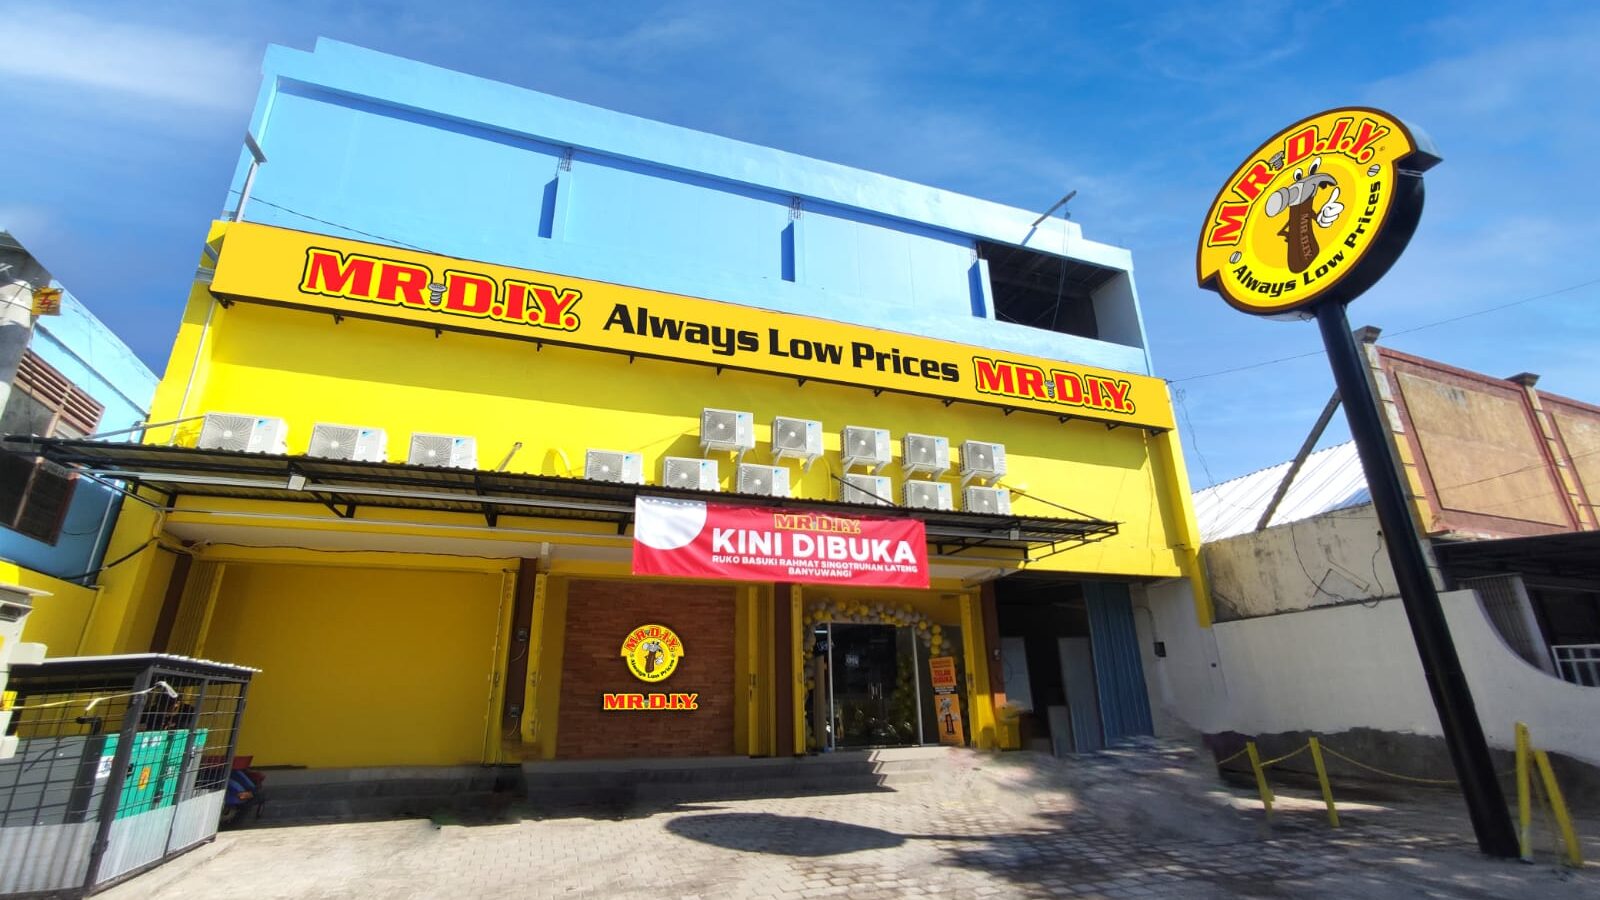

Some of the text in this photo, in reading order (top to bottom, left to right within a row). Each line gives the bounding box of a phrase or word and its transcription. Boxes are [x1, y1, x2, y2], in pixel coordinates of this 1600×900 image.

[1232, 181, 1381, 297] Always Low Prices
[603, 303, 960, 383] Always Low Prices
[712, 527, 917, 563] KINI DIBUKA
[712, 555, 918, 573] RUKO BASUKI RAHMAT SINGOTRUNAN LATENG
[788, 567, 852, 577] BANYUWANGI
